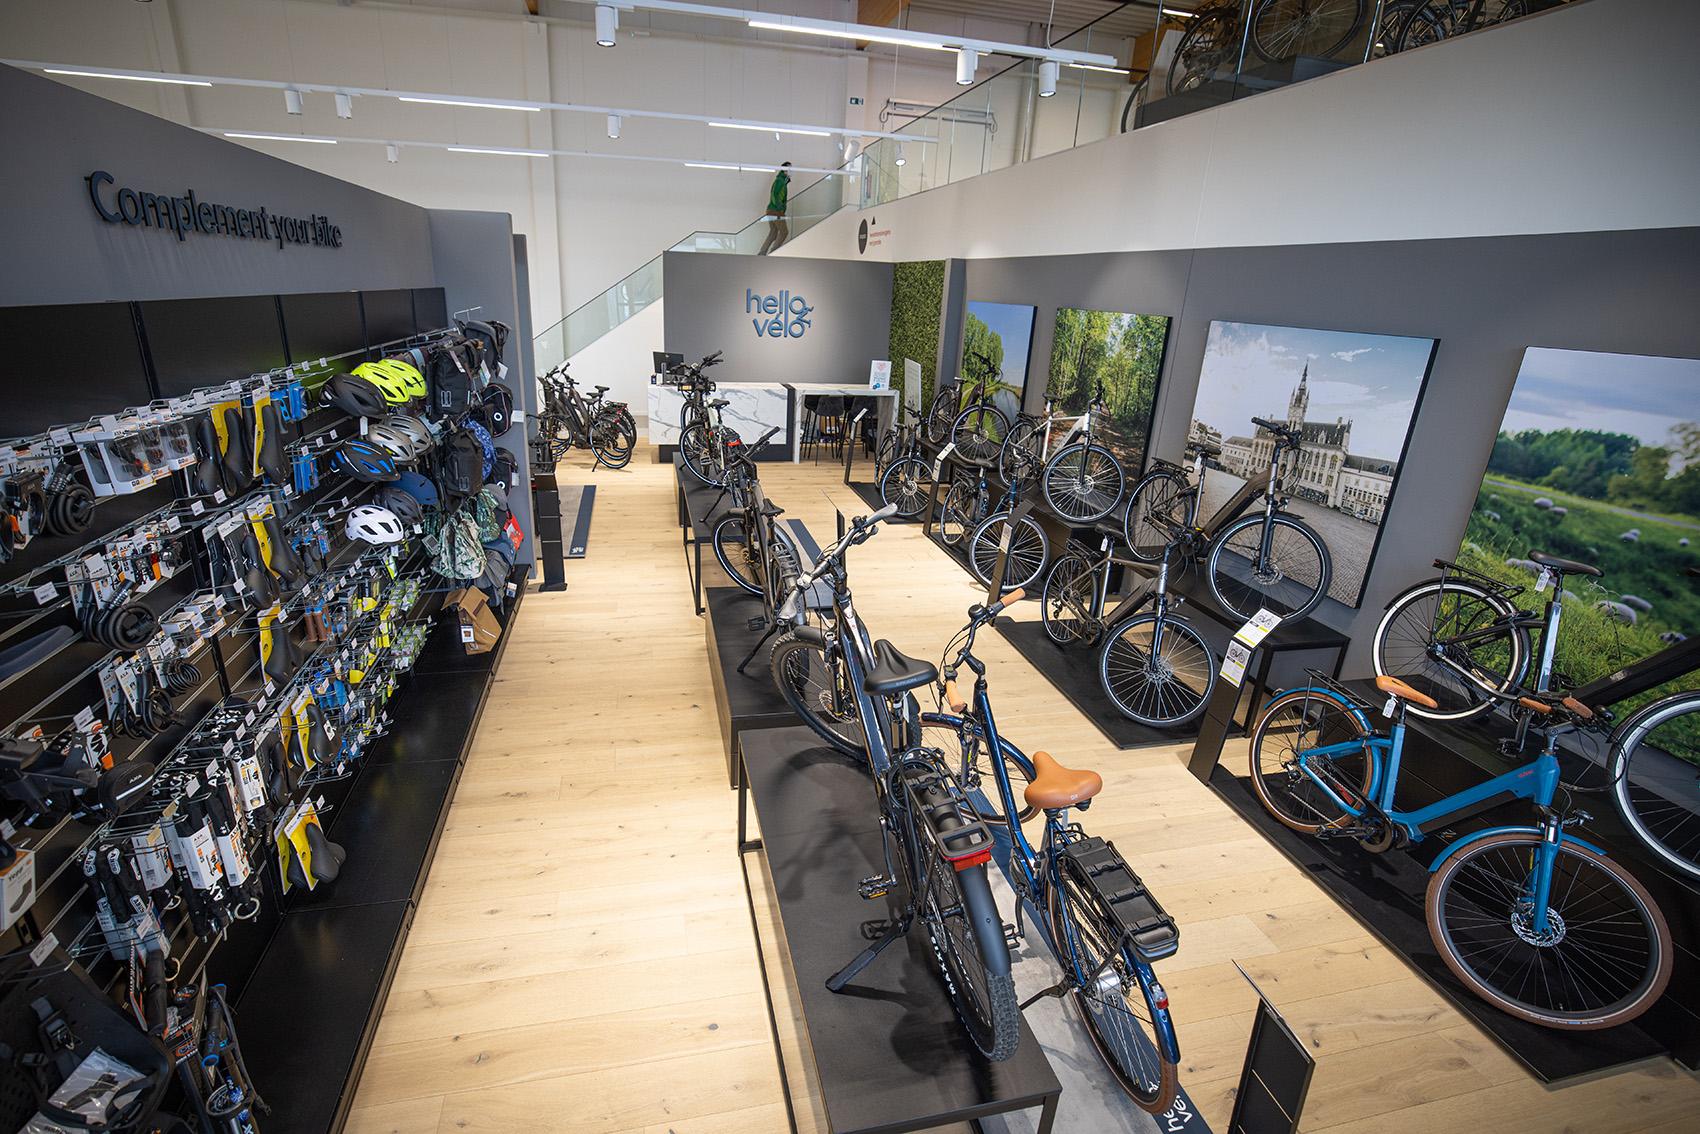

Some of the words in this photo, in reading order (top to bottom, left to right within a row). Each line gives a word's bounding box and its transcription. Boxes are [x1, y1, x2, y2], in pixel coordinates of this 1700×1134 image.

[86, 171, 271, 241] Complement
[271, 213, 312, 249] your
[311, 214, 343, 248] bike
[746, 288, 806, 315] hello
[753, 313, 806, 338] vélo
